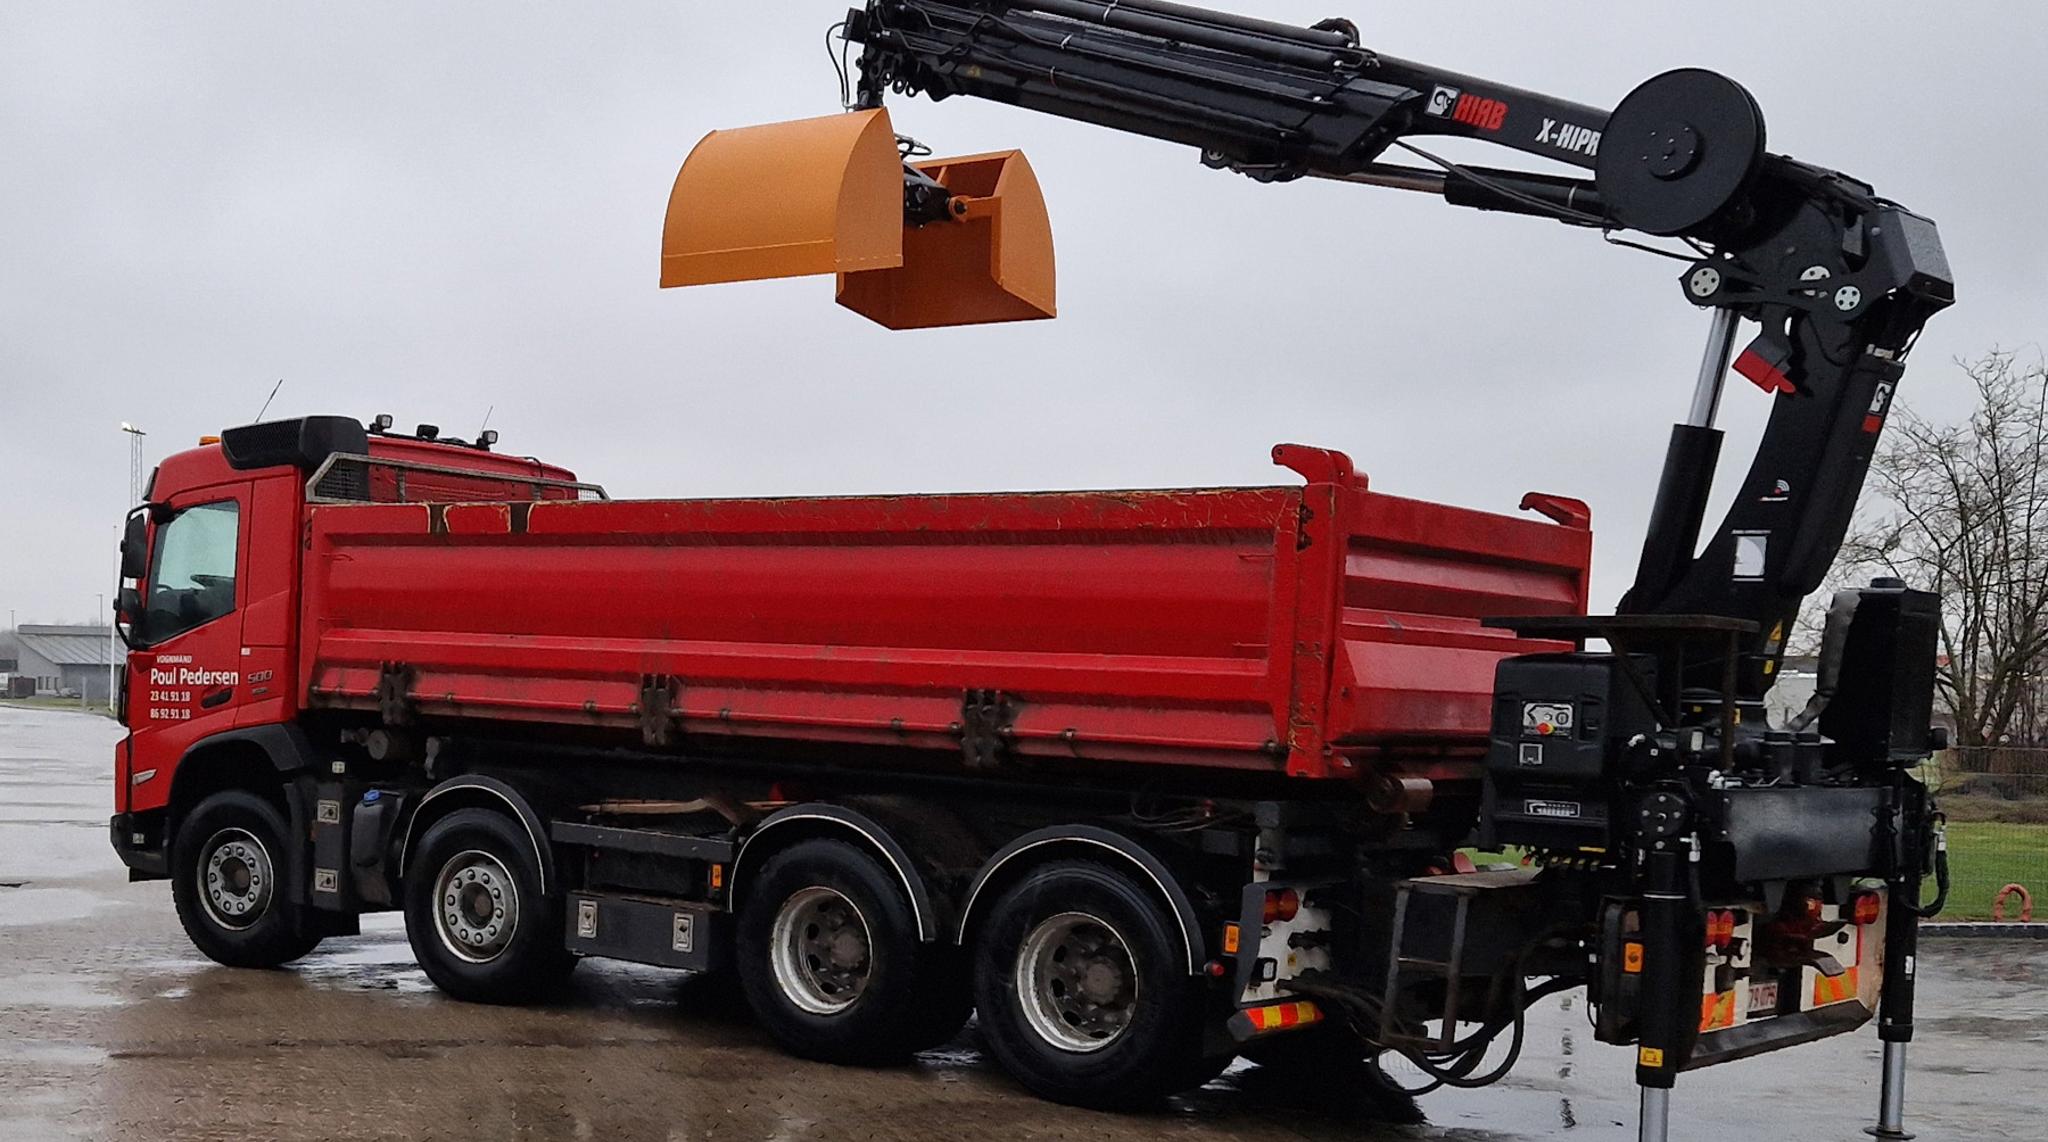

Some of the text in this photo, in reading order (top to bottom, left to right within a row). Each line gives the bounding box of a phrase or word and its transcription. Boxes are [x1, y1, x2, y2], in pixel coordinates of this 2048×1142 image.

[1453, 93, 1508, 130] HIAB
[156, 655, 193, 664] VOGNMAND
[150, 666, 239, 685] Poul Pedersen
[150, 690, 191, 701] 23 41 91 18
[160, 708, 169, 719] 92
[170, 708, 180, 719] 91
[181, 708, 191, 719] 18
